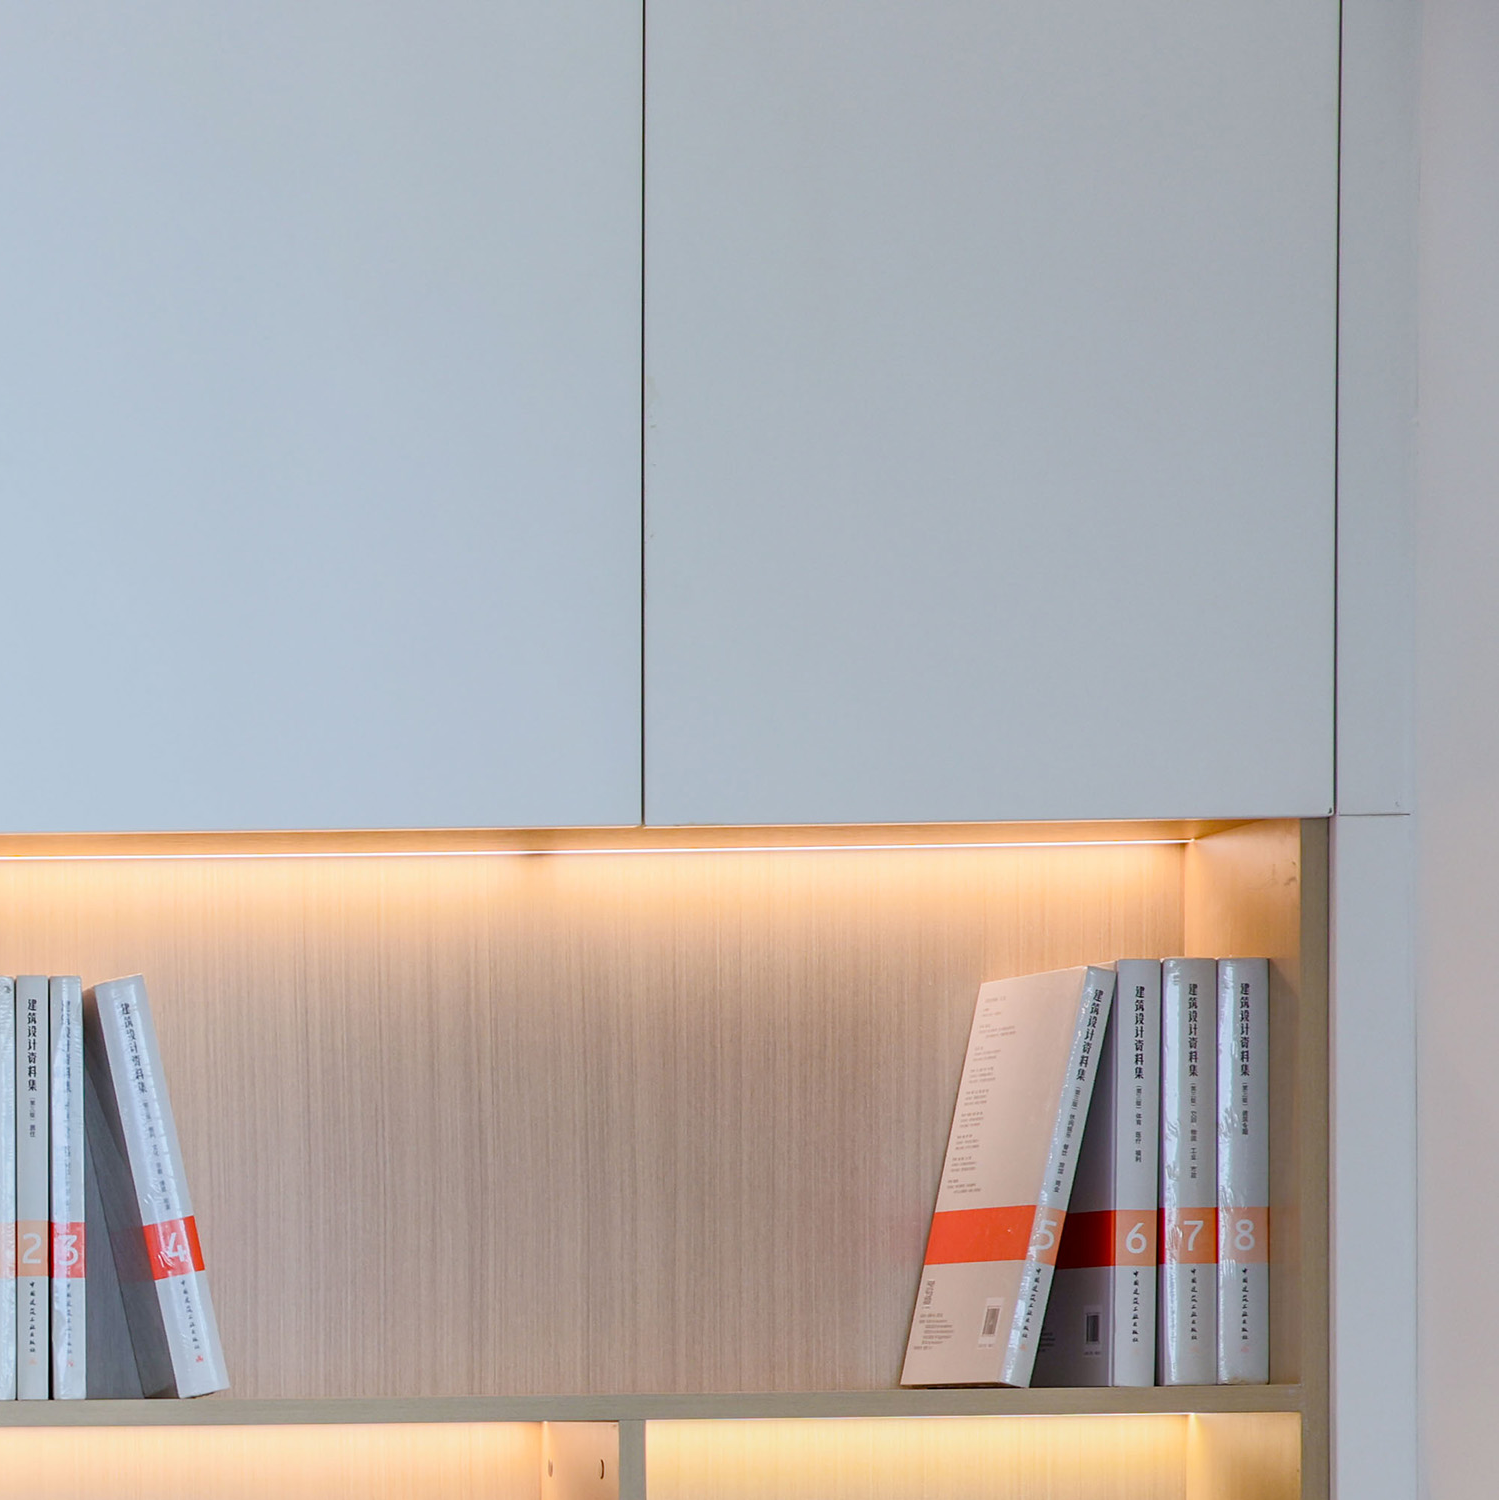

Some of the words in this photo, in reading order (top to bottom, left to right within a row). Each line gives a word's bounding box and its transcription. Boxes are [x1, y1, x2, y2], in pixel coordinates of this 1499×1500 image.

[27, 999, 37, 1091] 建筑设计资料集
[1076, 989, 1103, 1081] 建筑设计资料集
[1134, 986, 1145, 1079] 建筑设计资料集
[1188, 983, 1198, 1077] 建筑设计资料集
[1240, 983, 1250, 1076] 建筑设计资料集
[120, 1003, 148, 1093] 建筑设计资料集
[22, 1233, 42, 1264] 2
[59, 1235, 78, 1265] 3
[168, 1232, 186, 1262] 4
[1036, 1220, 1057, 1250] 5
[1125, 1222, 1147, 1253] 6
[1183, 1220, 1204, 1251] 7
[1234, 1219, 1255, 1251] 8
